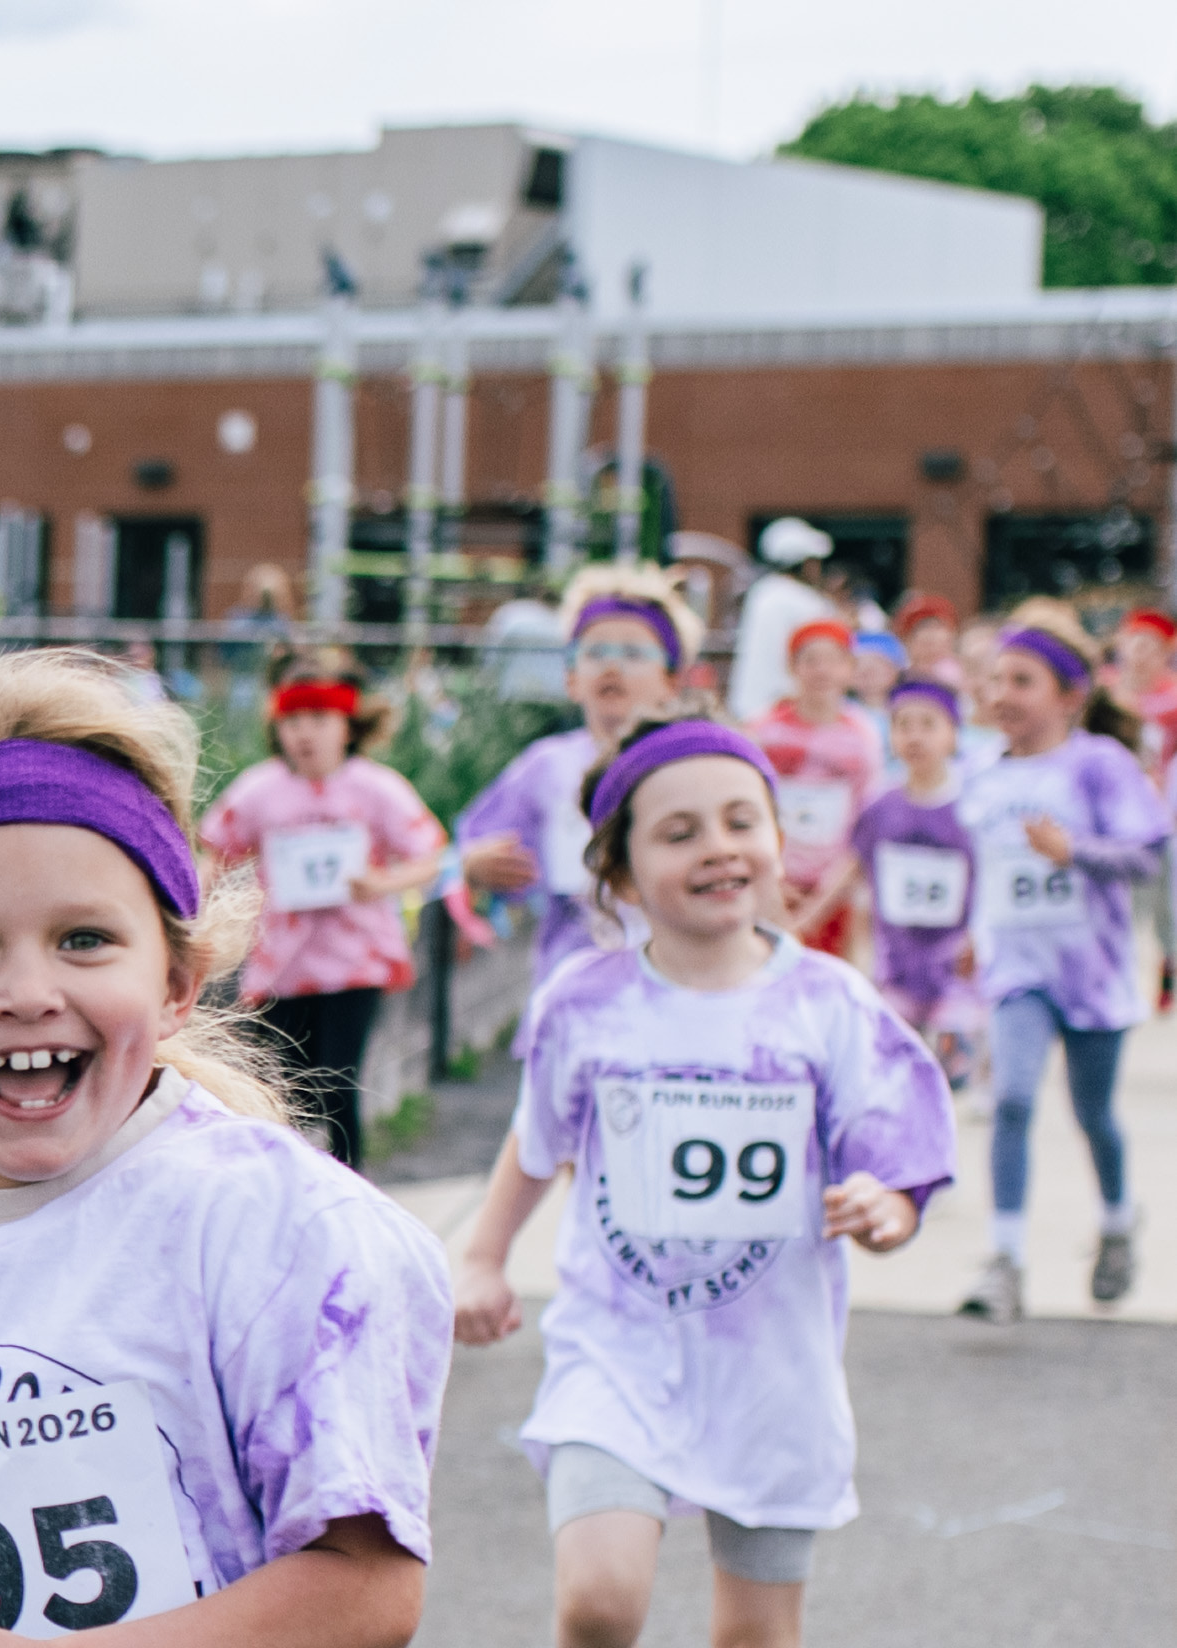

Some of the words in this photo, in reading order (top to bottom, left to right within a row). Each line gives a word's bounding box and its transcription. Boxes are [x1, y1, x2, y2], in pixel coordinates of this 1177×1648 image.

[652, 1090, 694, 1108] FUN
[698, 1091, 742, 1110] RUN
[671, 1138, 788, 1201] 99
[17, 1402, 117, 1447] 2026
